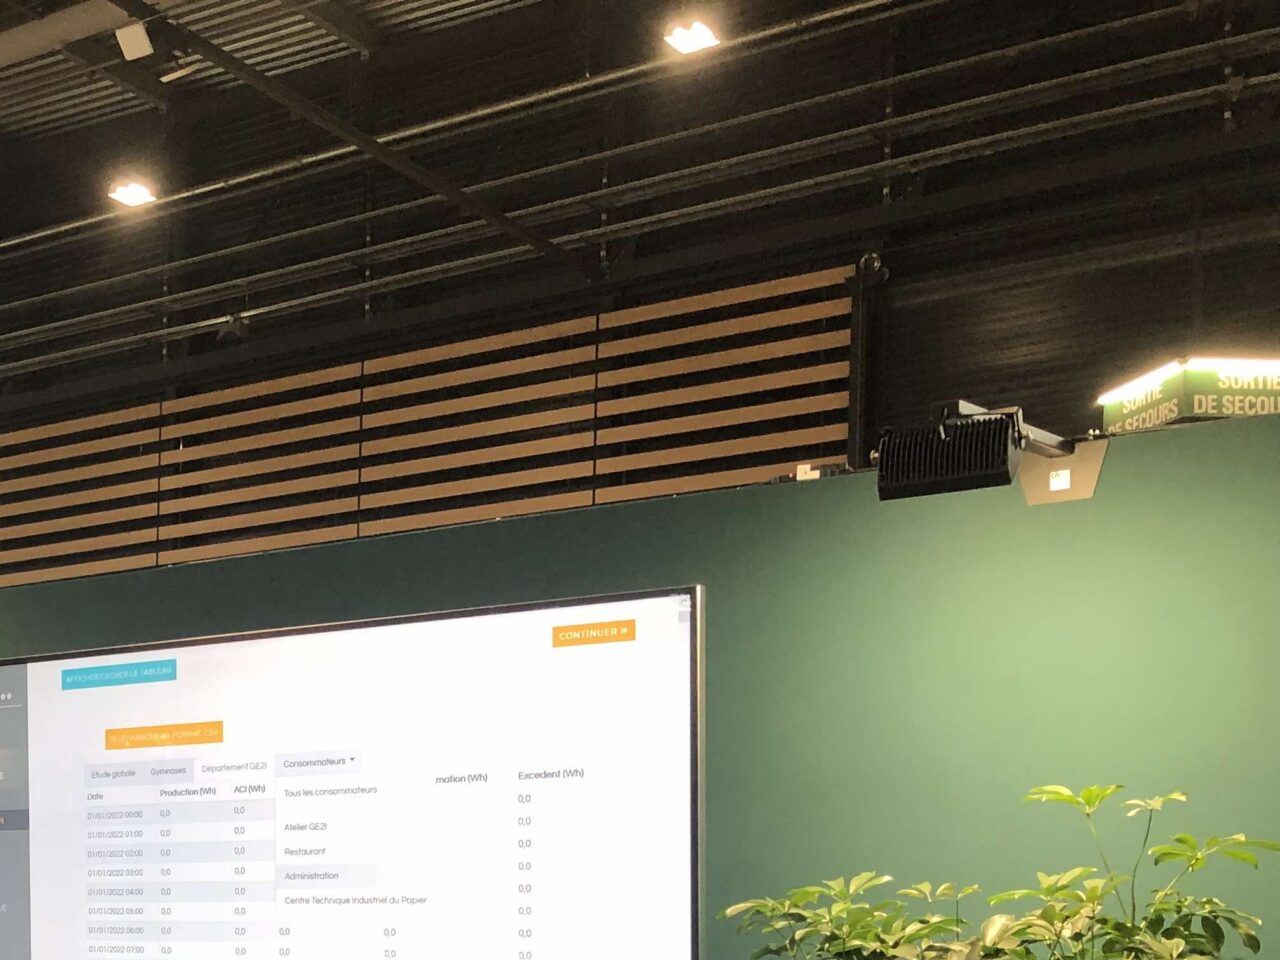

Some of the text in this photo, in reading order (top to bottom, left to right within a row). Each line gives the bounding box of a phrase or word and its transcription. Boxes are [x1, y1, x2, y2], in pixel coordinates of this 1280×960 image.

[1194, 394, 1218, 414] DE
[1125, 398, 1179, 431] SECOURS
[558, 627, 618, 641] CONTINUER
[283, 756, 347, 769] Consommateurs
[111, 769, 136, 780] globale
[150, 766, 187, 778] Gymnases
[201, 762, 249, 774] Département
[87, 792, 104, 801] Date
[160, 787, 199, 798] Production
[199, 786, 217, 797] (Wh)
[248, 784, 266, 795] (Wh)
[435, 774, 467, 785] mation
[467, 773, 488, 784] (Wh)
[562, 768, 585, 779] (Wh)
[284, 785, 378, 798] Tous les consommateurs
[518, 794, 532, 804] 0,0
[518, 817, 532, 826] 0,0
[284, 822, 308, 832] Atelier
[518, 839, 532, 849] 0,0
[284, 847, 327, 857] Restaurant
[518, 862, 532, 871] 0,0
[284, 871, 340, 881] Administration
[518, 884, 532, 894] 0,0
[285, 895, 428, 907] Centre Technique Industriel du Papier
[518, 907, 532, 917] 0,0
[518, 929, 532, 939] 0,0
[518, 952, 532, 960] 0,0
